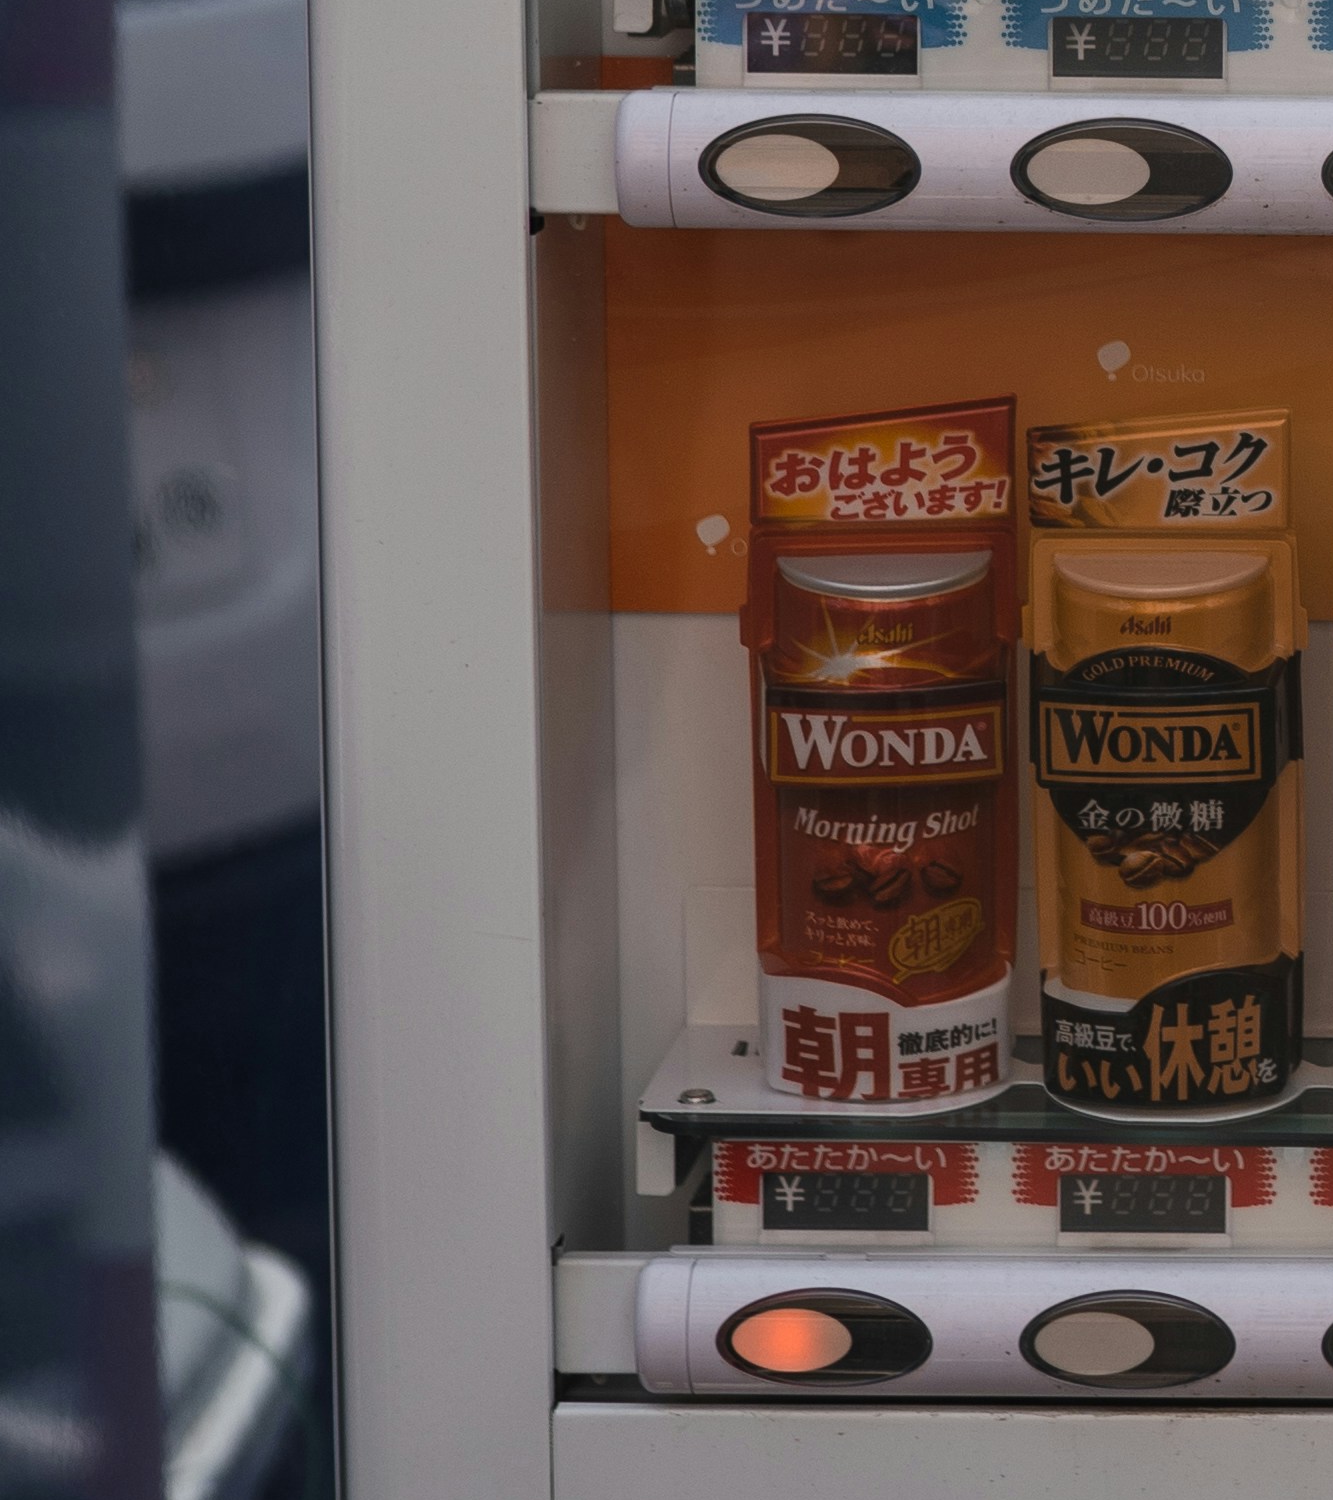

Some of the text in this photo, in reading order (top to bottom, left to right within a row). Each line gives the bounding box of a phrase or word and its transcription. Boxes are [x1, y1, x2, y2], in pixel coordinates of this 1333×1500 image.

[771, 434, 977, 494] おはよう
[1035, 433, 1270, 507] キレ・コク
[1083, 656, 1214, 683] GOLD PREMIUM
[782, 714, 988, 768] WONDA
[1055, 709, 1241, 766] WONDA
[794, 805, 978, 853] Morning Shot
[783, 1004, 890, 1101] 朝
[898, 1043, 998, 1099] 専用
